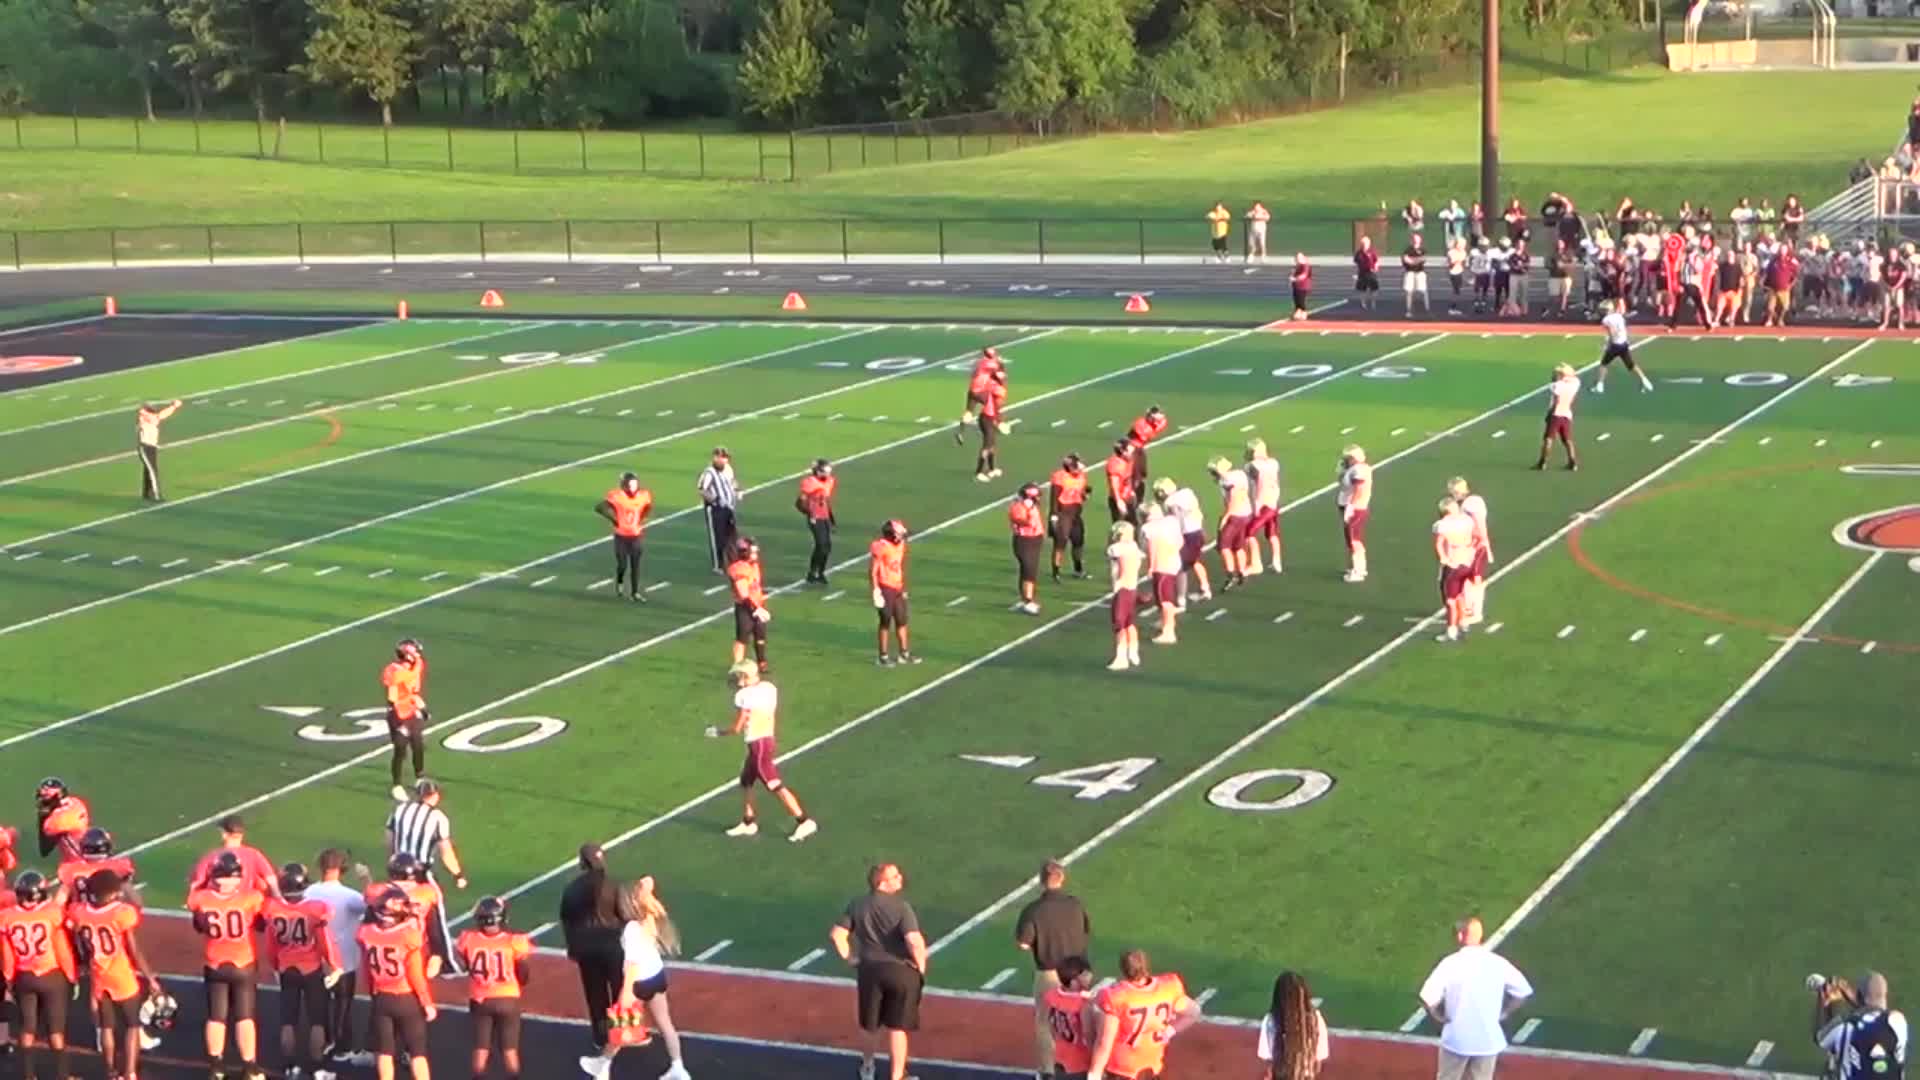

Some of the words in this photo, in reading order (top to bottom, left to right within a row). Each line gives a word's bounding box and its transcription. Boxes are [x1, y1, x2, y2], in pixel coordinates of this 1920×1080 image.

[1030, 757, 1336, 810] 40
[11, 923, 47, 956] 32
[208, 910, 243, 939] 60
[273, 917, 308, 945] 24
[368, 946, 400, 977] 45
[471, 951, 507, 982] 41
[1128, 1005, 1172, 1047] 73
